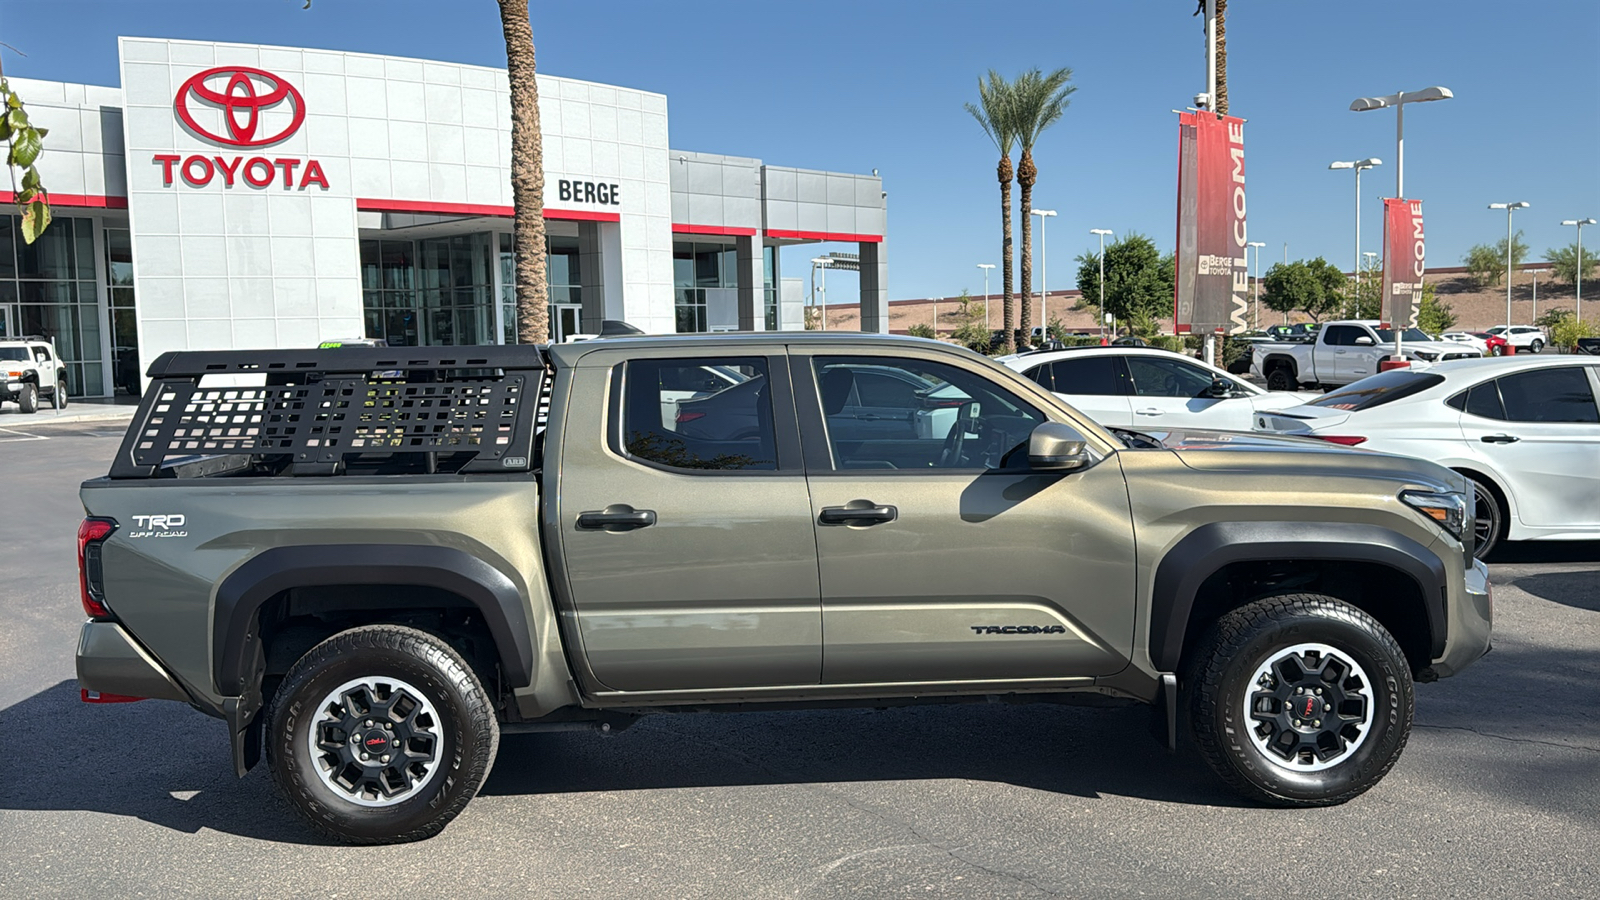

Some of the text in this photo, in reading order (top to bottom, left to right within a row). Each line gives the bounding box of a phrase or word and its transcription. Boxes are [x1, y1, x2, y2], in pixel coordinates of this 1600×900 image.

[153, 154, 330, 190] TOYOTA
[558, 179, 620, 206] BERGE
[1228, 121, 1248, 335] WELCOME
[1209, 267, 1232, 276] TOYOTA
[1408, 202, 1426, 329] WELCOME
[132, 514, 186, 531] TRD
[970, 625, 1066, 635] TACOMA
